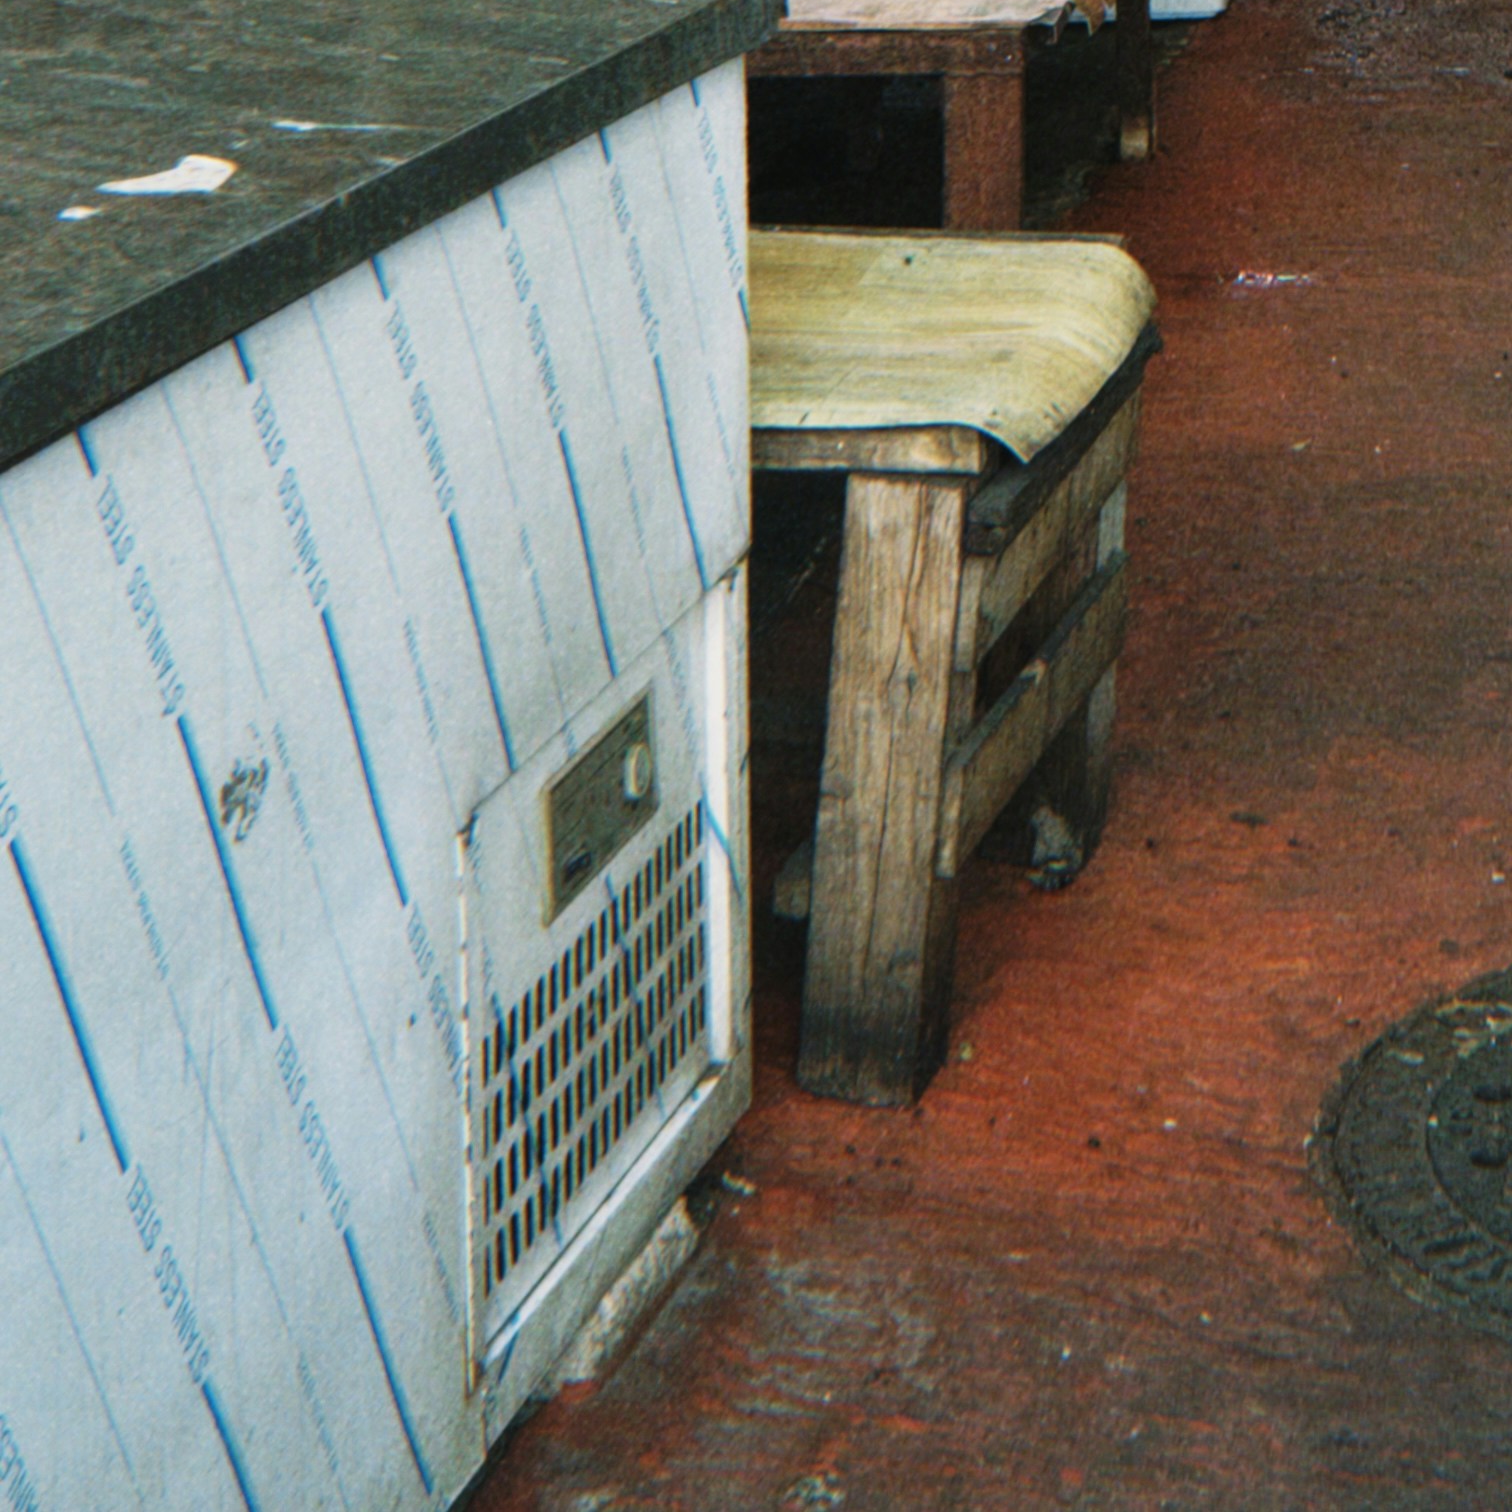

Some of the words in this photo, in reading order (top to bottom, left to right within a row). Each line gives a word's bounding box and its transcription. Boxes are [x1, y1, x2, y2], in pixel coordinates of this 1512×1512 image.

[253, 379, 286, 468] STEEL
[97, 474, 136, 566] STEEL
[278, 466, 329, 608] STAINLESS
[127, 563, 186, 718] STAINLESS
[275, 1023, 307, 1106] STEEL
[126, 1163, 162, 1253] STEEL
[299, 1100, 351, 1231] STAINLESS
[154, 1244, 211, 1384] STAINLESS
